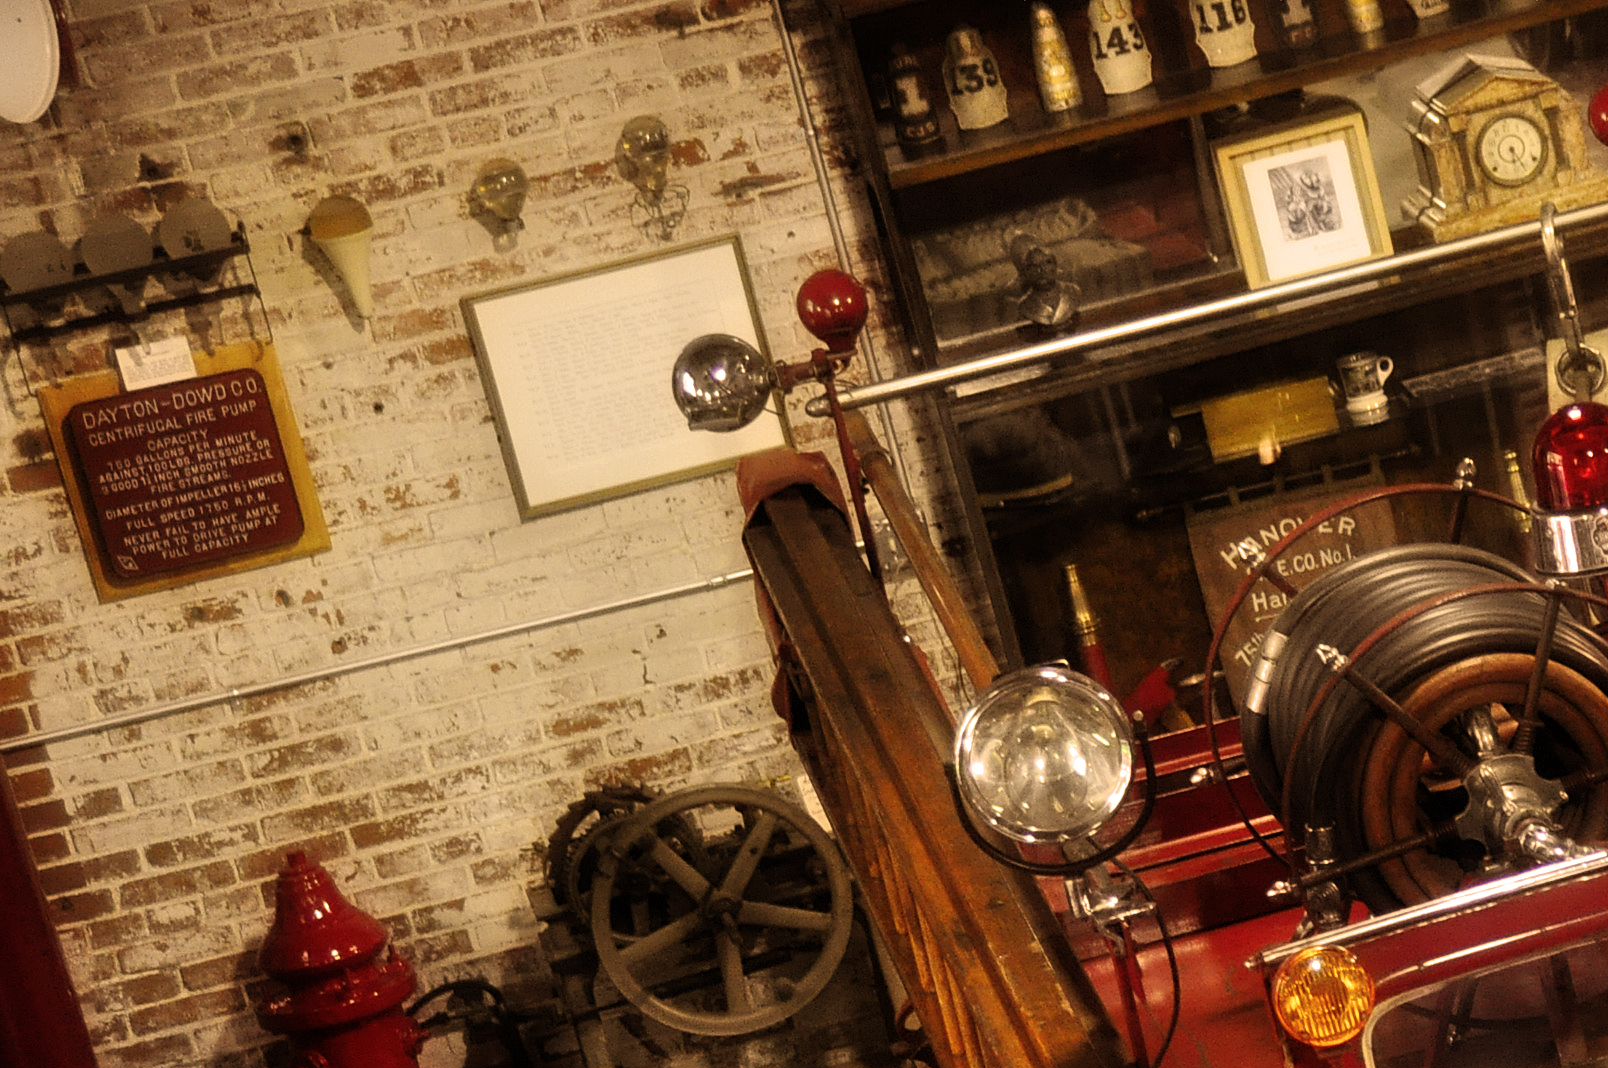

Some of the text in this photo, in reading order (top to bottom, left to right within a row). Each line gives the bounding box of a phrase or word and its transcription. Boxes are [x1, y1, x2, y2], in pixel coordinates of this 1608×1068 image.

[1092, 21, 1144, 60] 143
[896, 73, 930, 117] 1
[82, 376, 262, 430] DAYTON-DOWD CO.
[88, 399, 258, 447] CENTRIFUGAL FIRE PUMP
[99, 466, 146, 484] AGAINST
[196, 442, 253, 461] PRESSURE
[256, 438, 270, 450] OR
[135, 446, 185, 465] GALLONS
[188, 440, 210, 454] PER
[215, 430, 258, 448] MINUTE
[147, 428, 209, 452] CAPACITY
[110, 478, 139, 493] GOOD
[154, 468, 180, 484] INCH
[184, 459, 227, 477] SMOOTH
[230, 449, 274, 466] NOZZLE
[150, 481, 176, 494] FIRE
[105, 500, 160, 520] DIAMETER
[160, 496, 174, 508] OF
[175, 484, 228, 505] IMPELLER
[248, 471, 286, 490] INCHES
[126, 491, 270, 531] FULL SPEED 1750 R.P.M.
[124, 502, 281, 547] NEVER FAIL TO HAVE AMPLE
[132, 516, 278, 556] POWER TO DRIVE PUMP AT
[162, 533, 250, 560] FULL CAPACITY
